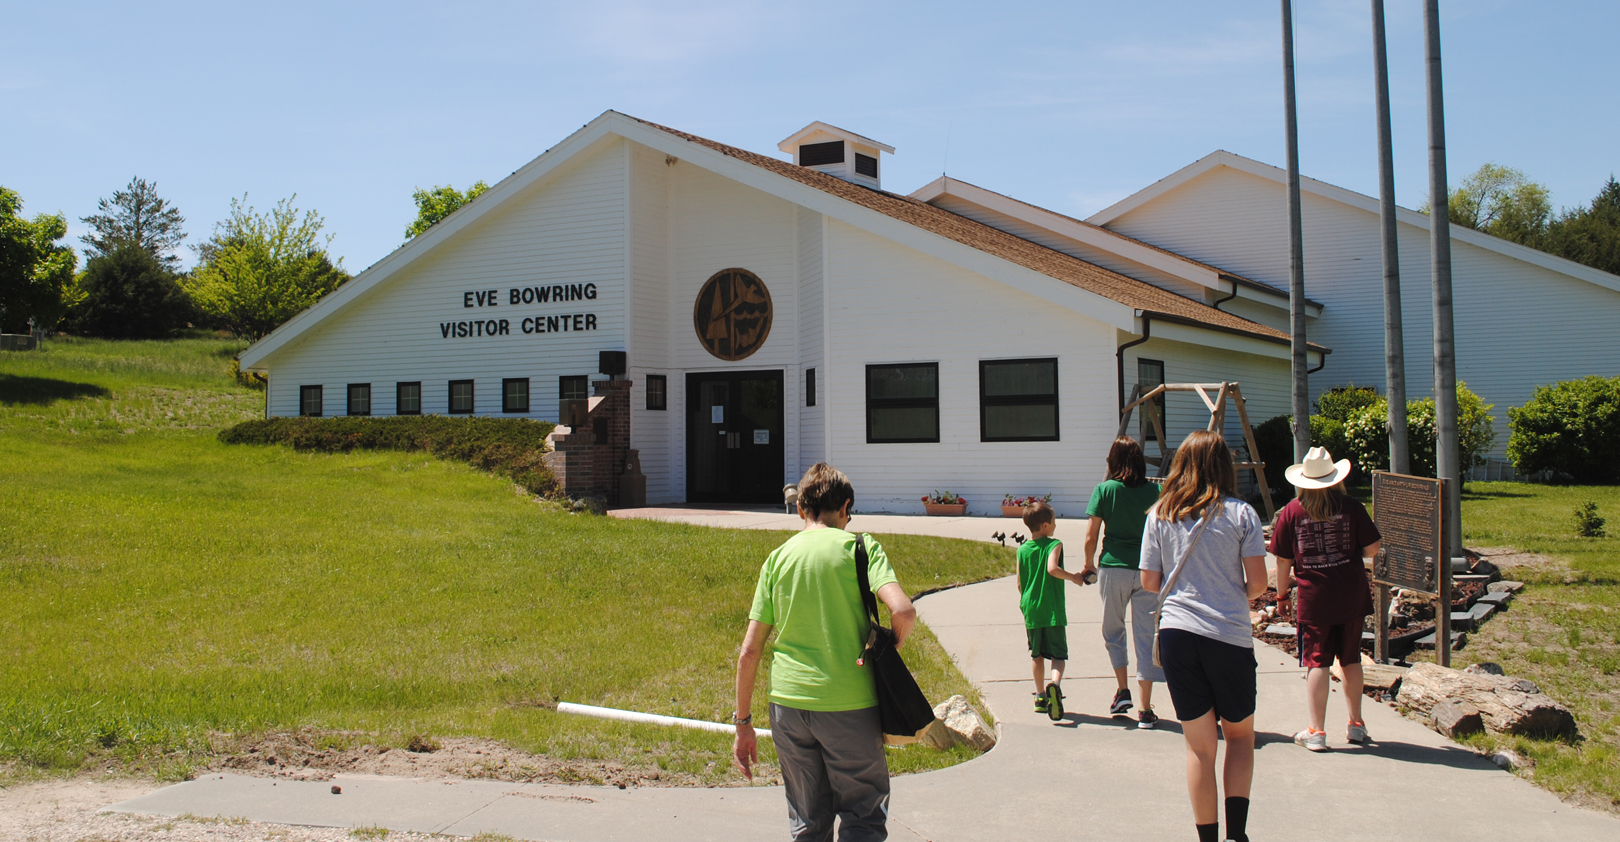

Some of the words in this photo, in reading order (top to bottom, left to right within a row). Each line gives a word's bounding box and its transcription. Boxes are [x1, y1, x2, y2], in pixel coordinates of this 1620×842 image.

[464, 290, 498, 308] EVE
[509, 283, 597, 305] BOWRING
[440, 319, 510, 339] VISITOR
[521, 313, 597, 334] CENTER
